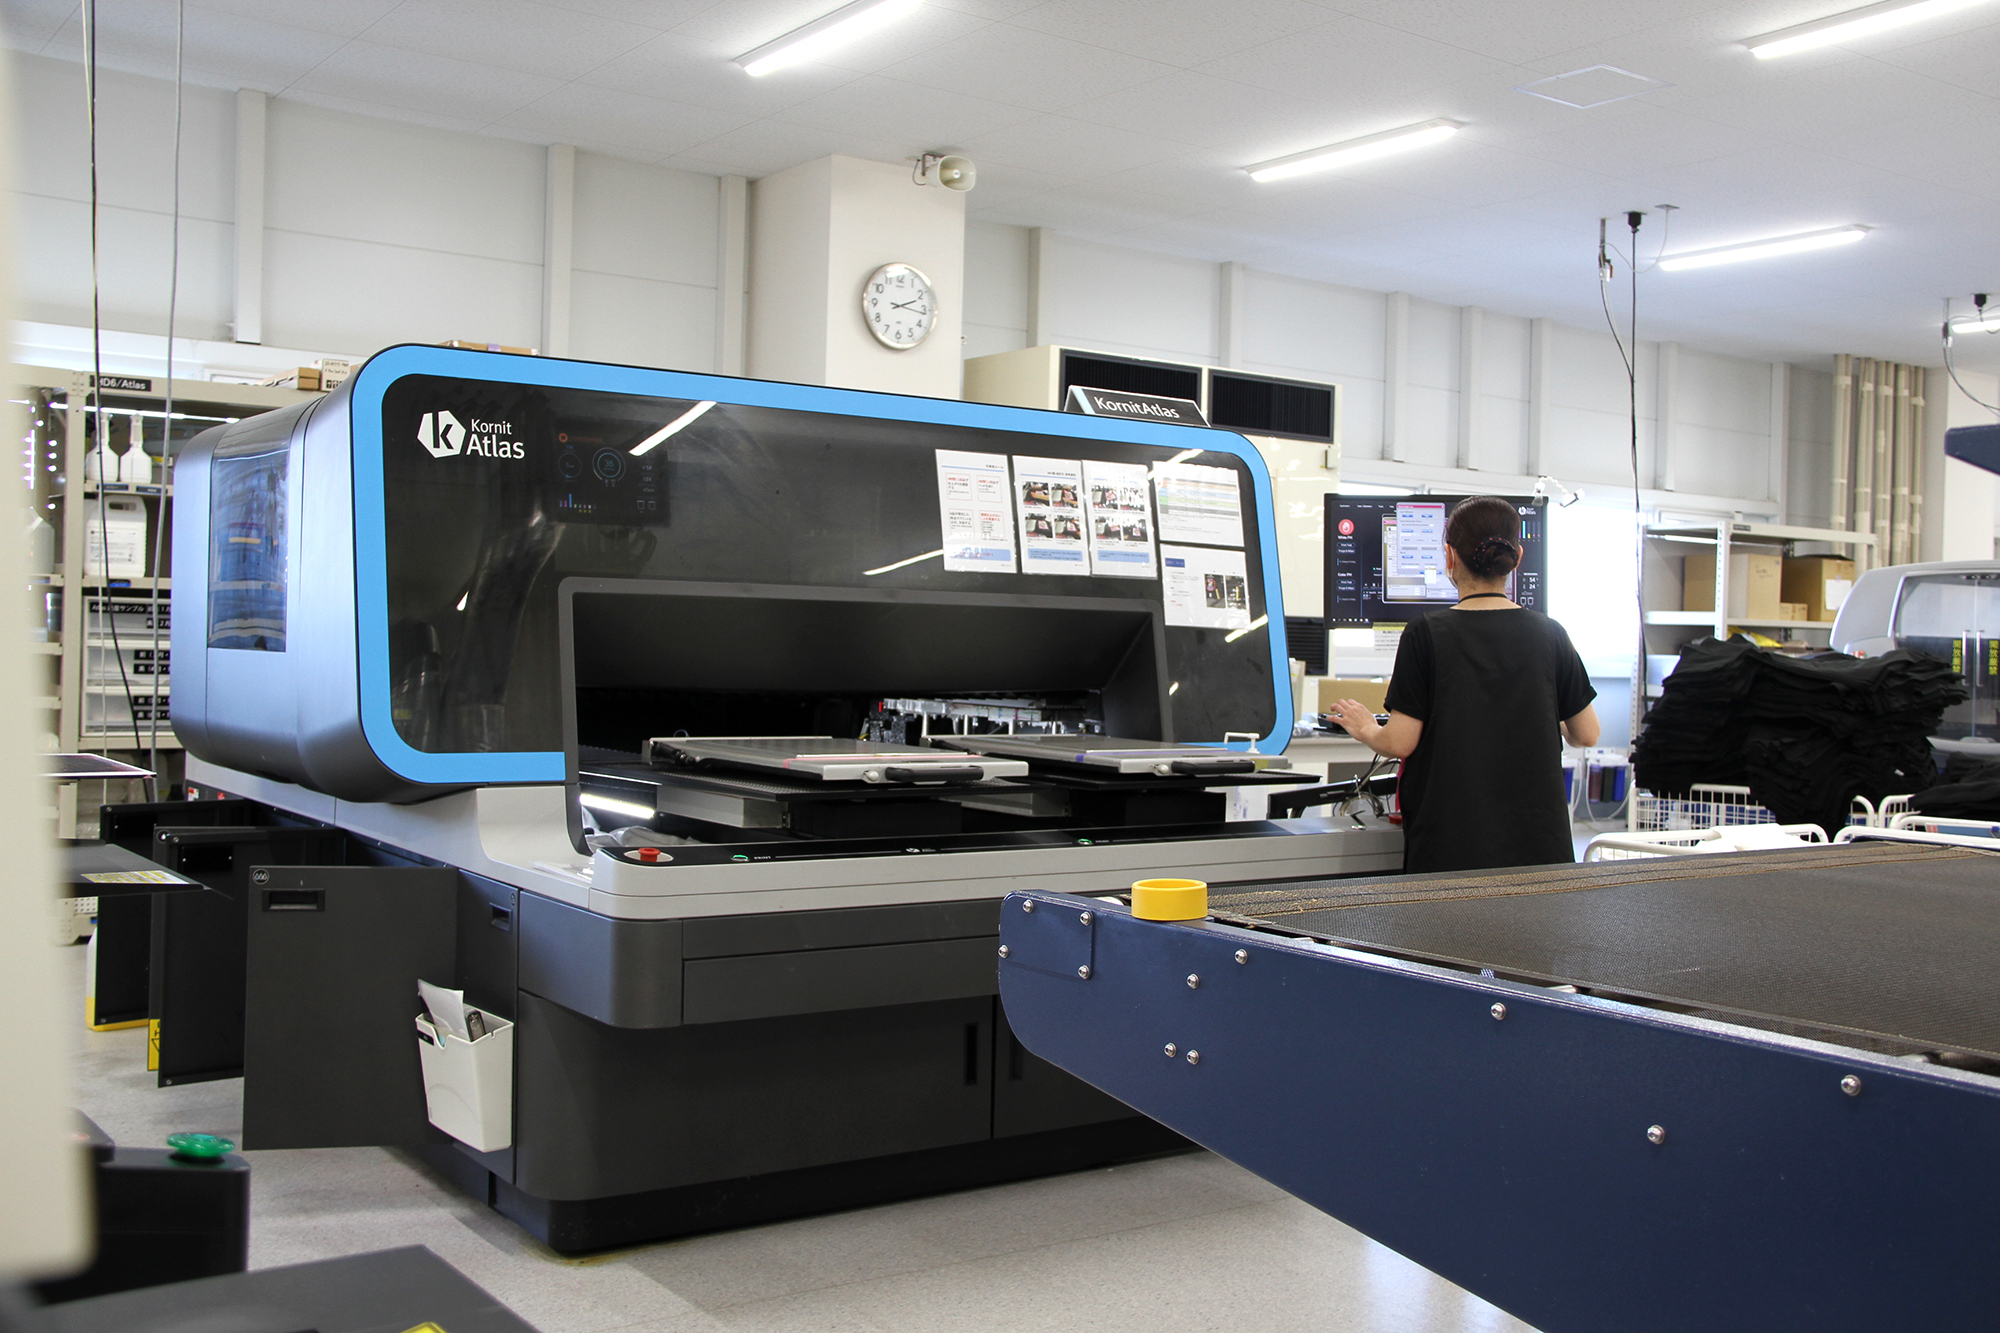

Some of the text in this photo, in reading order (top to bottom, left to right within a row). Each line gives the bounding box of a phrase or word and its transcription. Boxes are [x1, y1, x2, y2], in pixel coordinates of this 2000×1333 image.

[875, 283, 884, 294] 10
[910, 279, 914, 288] 1
[917, 290, 923, 300] 2
[871, 298, 878, 307] 9
[921, 305, 927, 314] 3
[875, 312, 881, 323] 8
[884, 324, 890, 333] 7
[916, 319, 922, 328] 4
[895, 329, 902, 340] 6
[908, 328, 914, 337] 5
[1094, 396, 1180, 419] KornitAtlas
[471, 418, 512, 435] Kornit
[466, 433, 525, 459] Atlas
